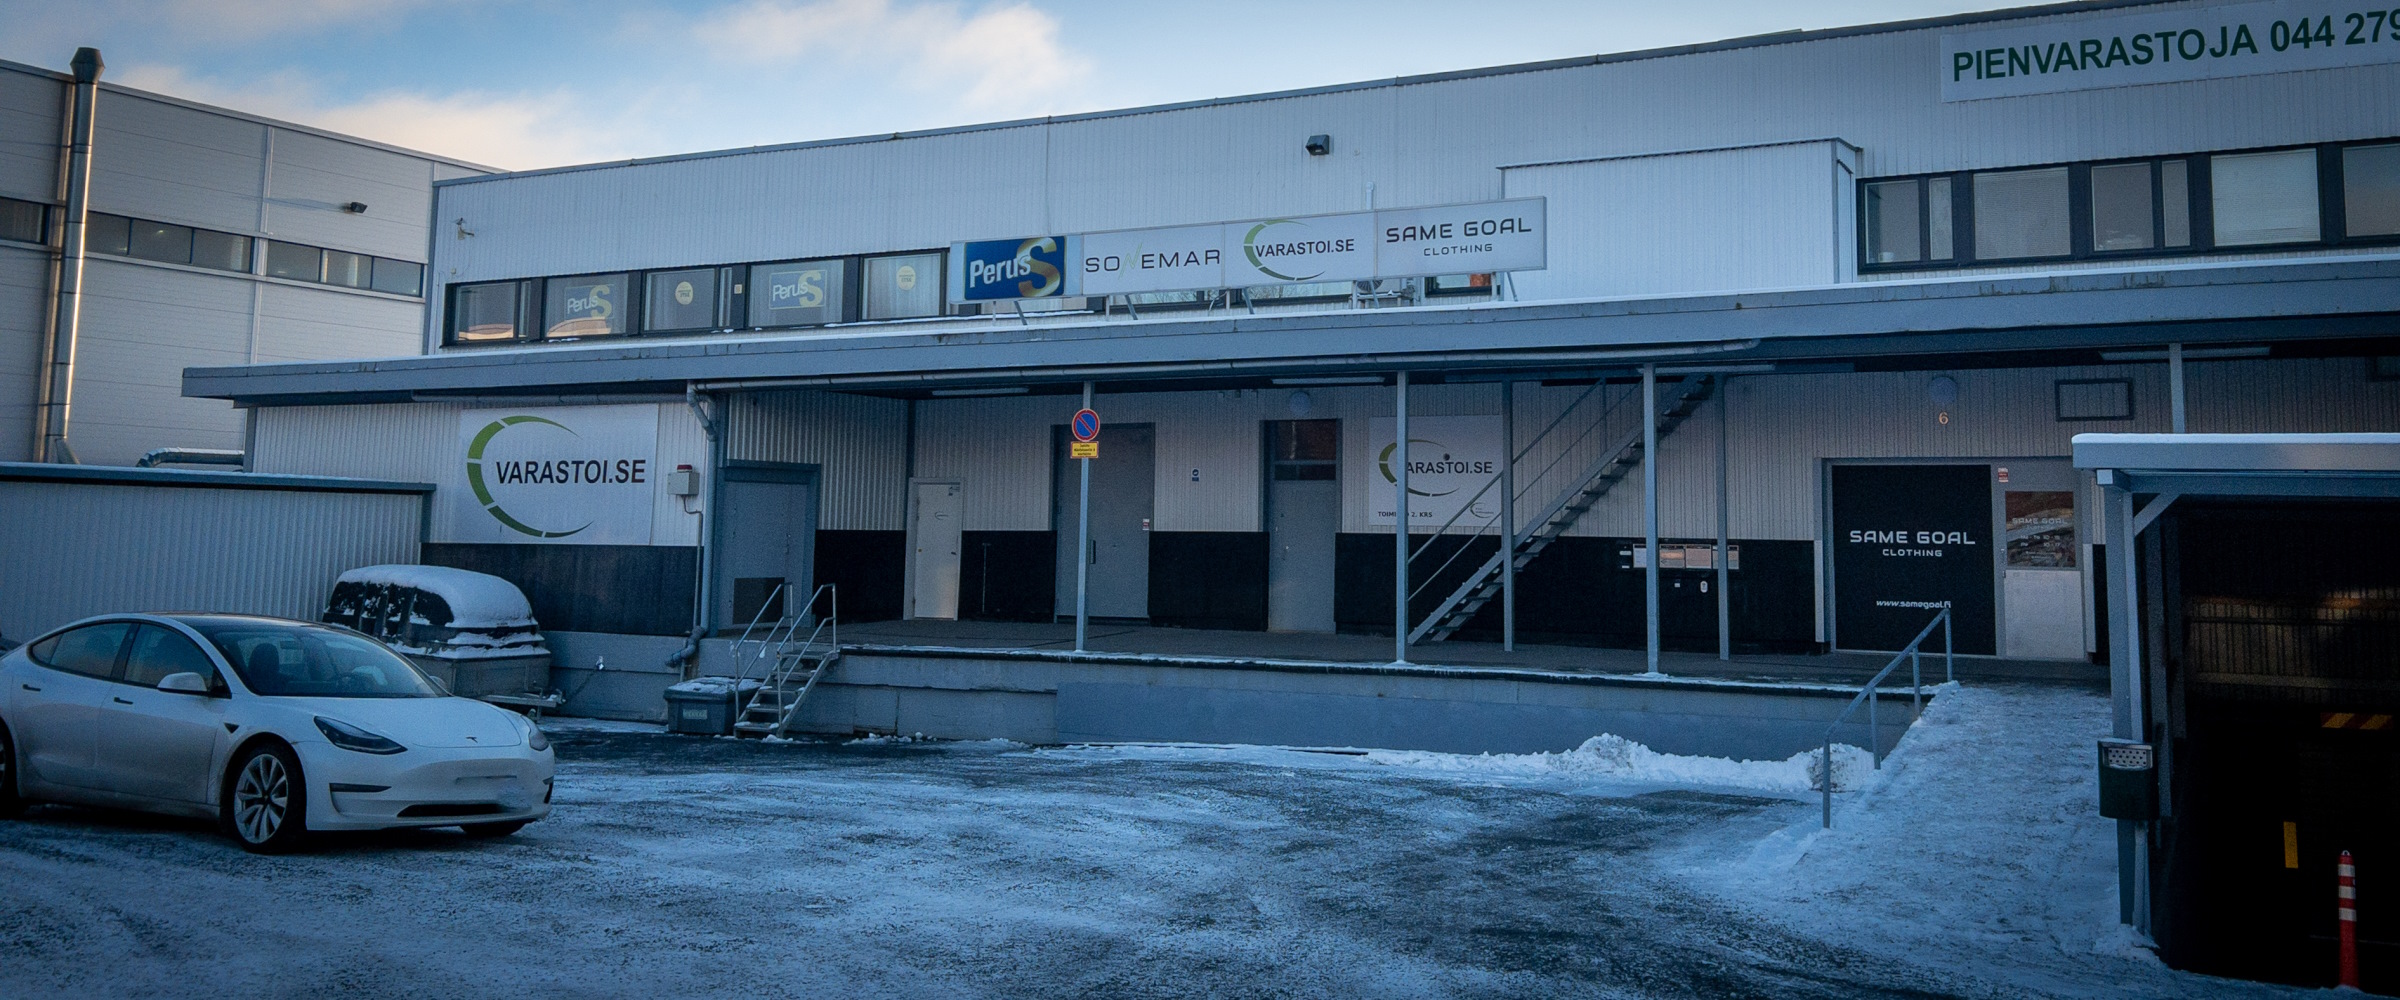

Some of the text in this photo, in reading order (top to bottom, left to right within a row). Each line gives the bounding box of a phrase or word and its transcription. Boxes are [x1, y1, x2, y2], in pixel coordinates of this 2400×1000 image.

[1952, 24, 2258, 82] PIENVARASTOJA
[2270, 15, 2335, 52] 044
[1386, 217, 1532, 243] SAME GOAL
[1255, 237, 1355, 259] VARASTOI.SE
[1423, 242, 1494, 257] CLOTHING
[1938, 411, 1949, 425] 6
[496, 459, 646, 484] VARASTOI.SE
[1407, 461, 1493, 474] ARASTOI.SE
[1850, 530, 1976, 545] SAME GOAL
[1882, 548, 1943, 557] CLOTHING
[1876, 600, 1951, 610] www.samegoal.fi
